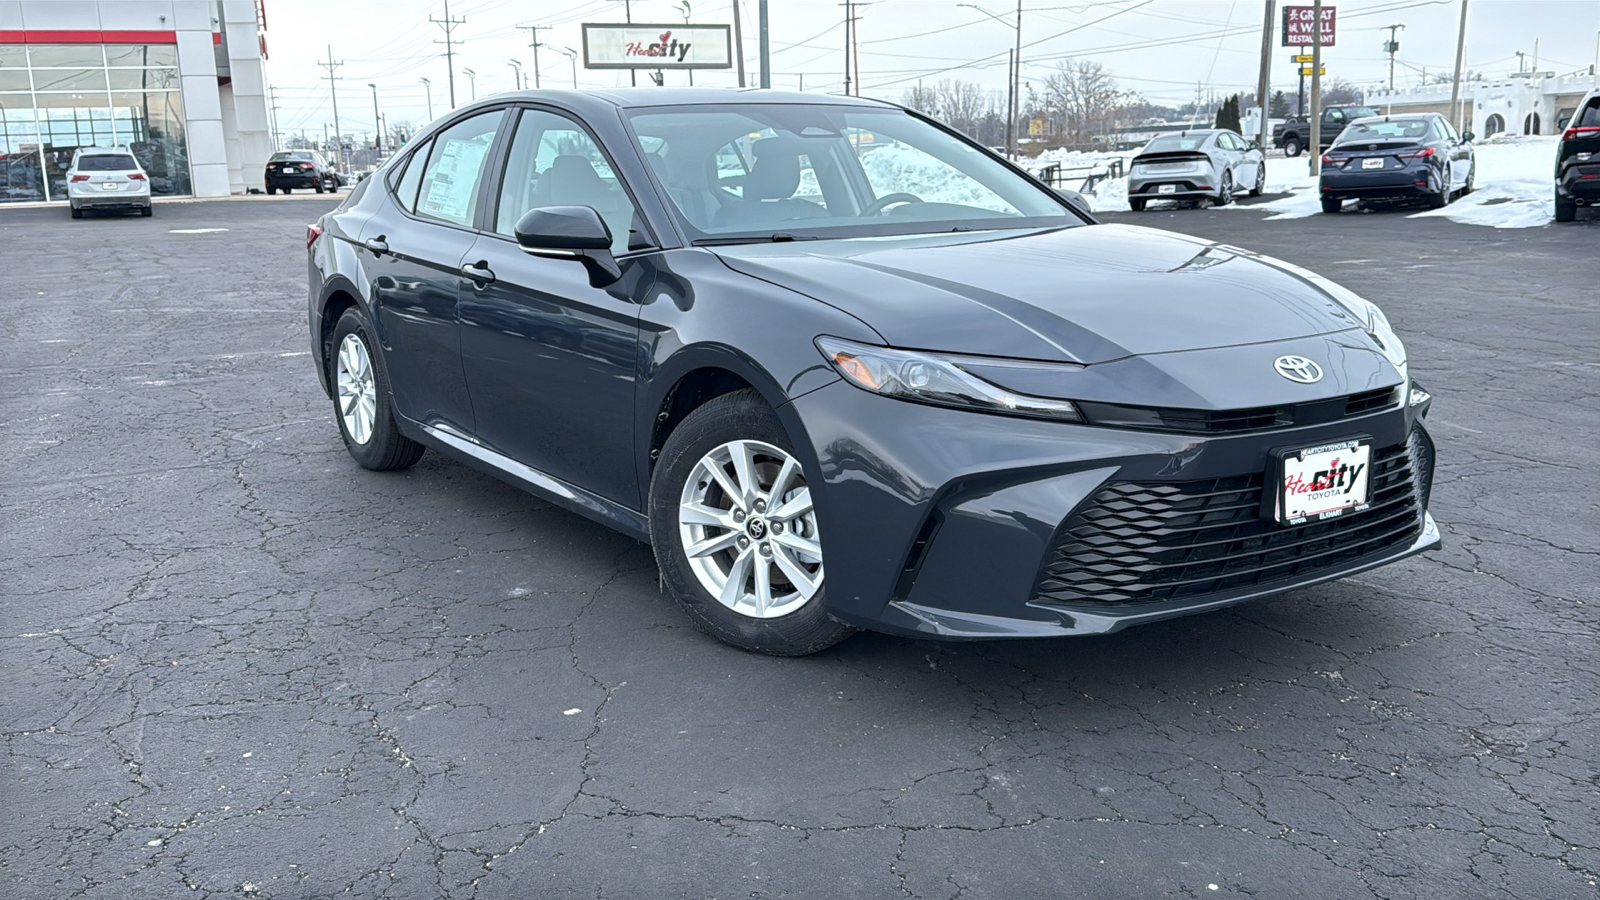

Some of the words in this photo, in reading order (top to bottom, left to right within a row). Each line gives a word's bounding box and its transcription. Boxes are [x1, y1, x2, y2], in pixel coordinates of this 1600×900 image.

[1300, 10, 1334, 20] GRAT
[1300, 22, 1332, 33] WLL
[1285, 472, 1342, 496] Heart
[1307, 489, 1341, 501] TOYOTA
